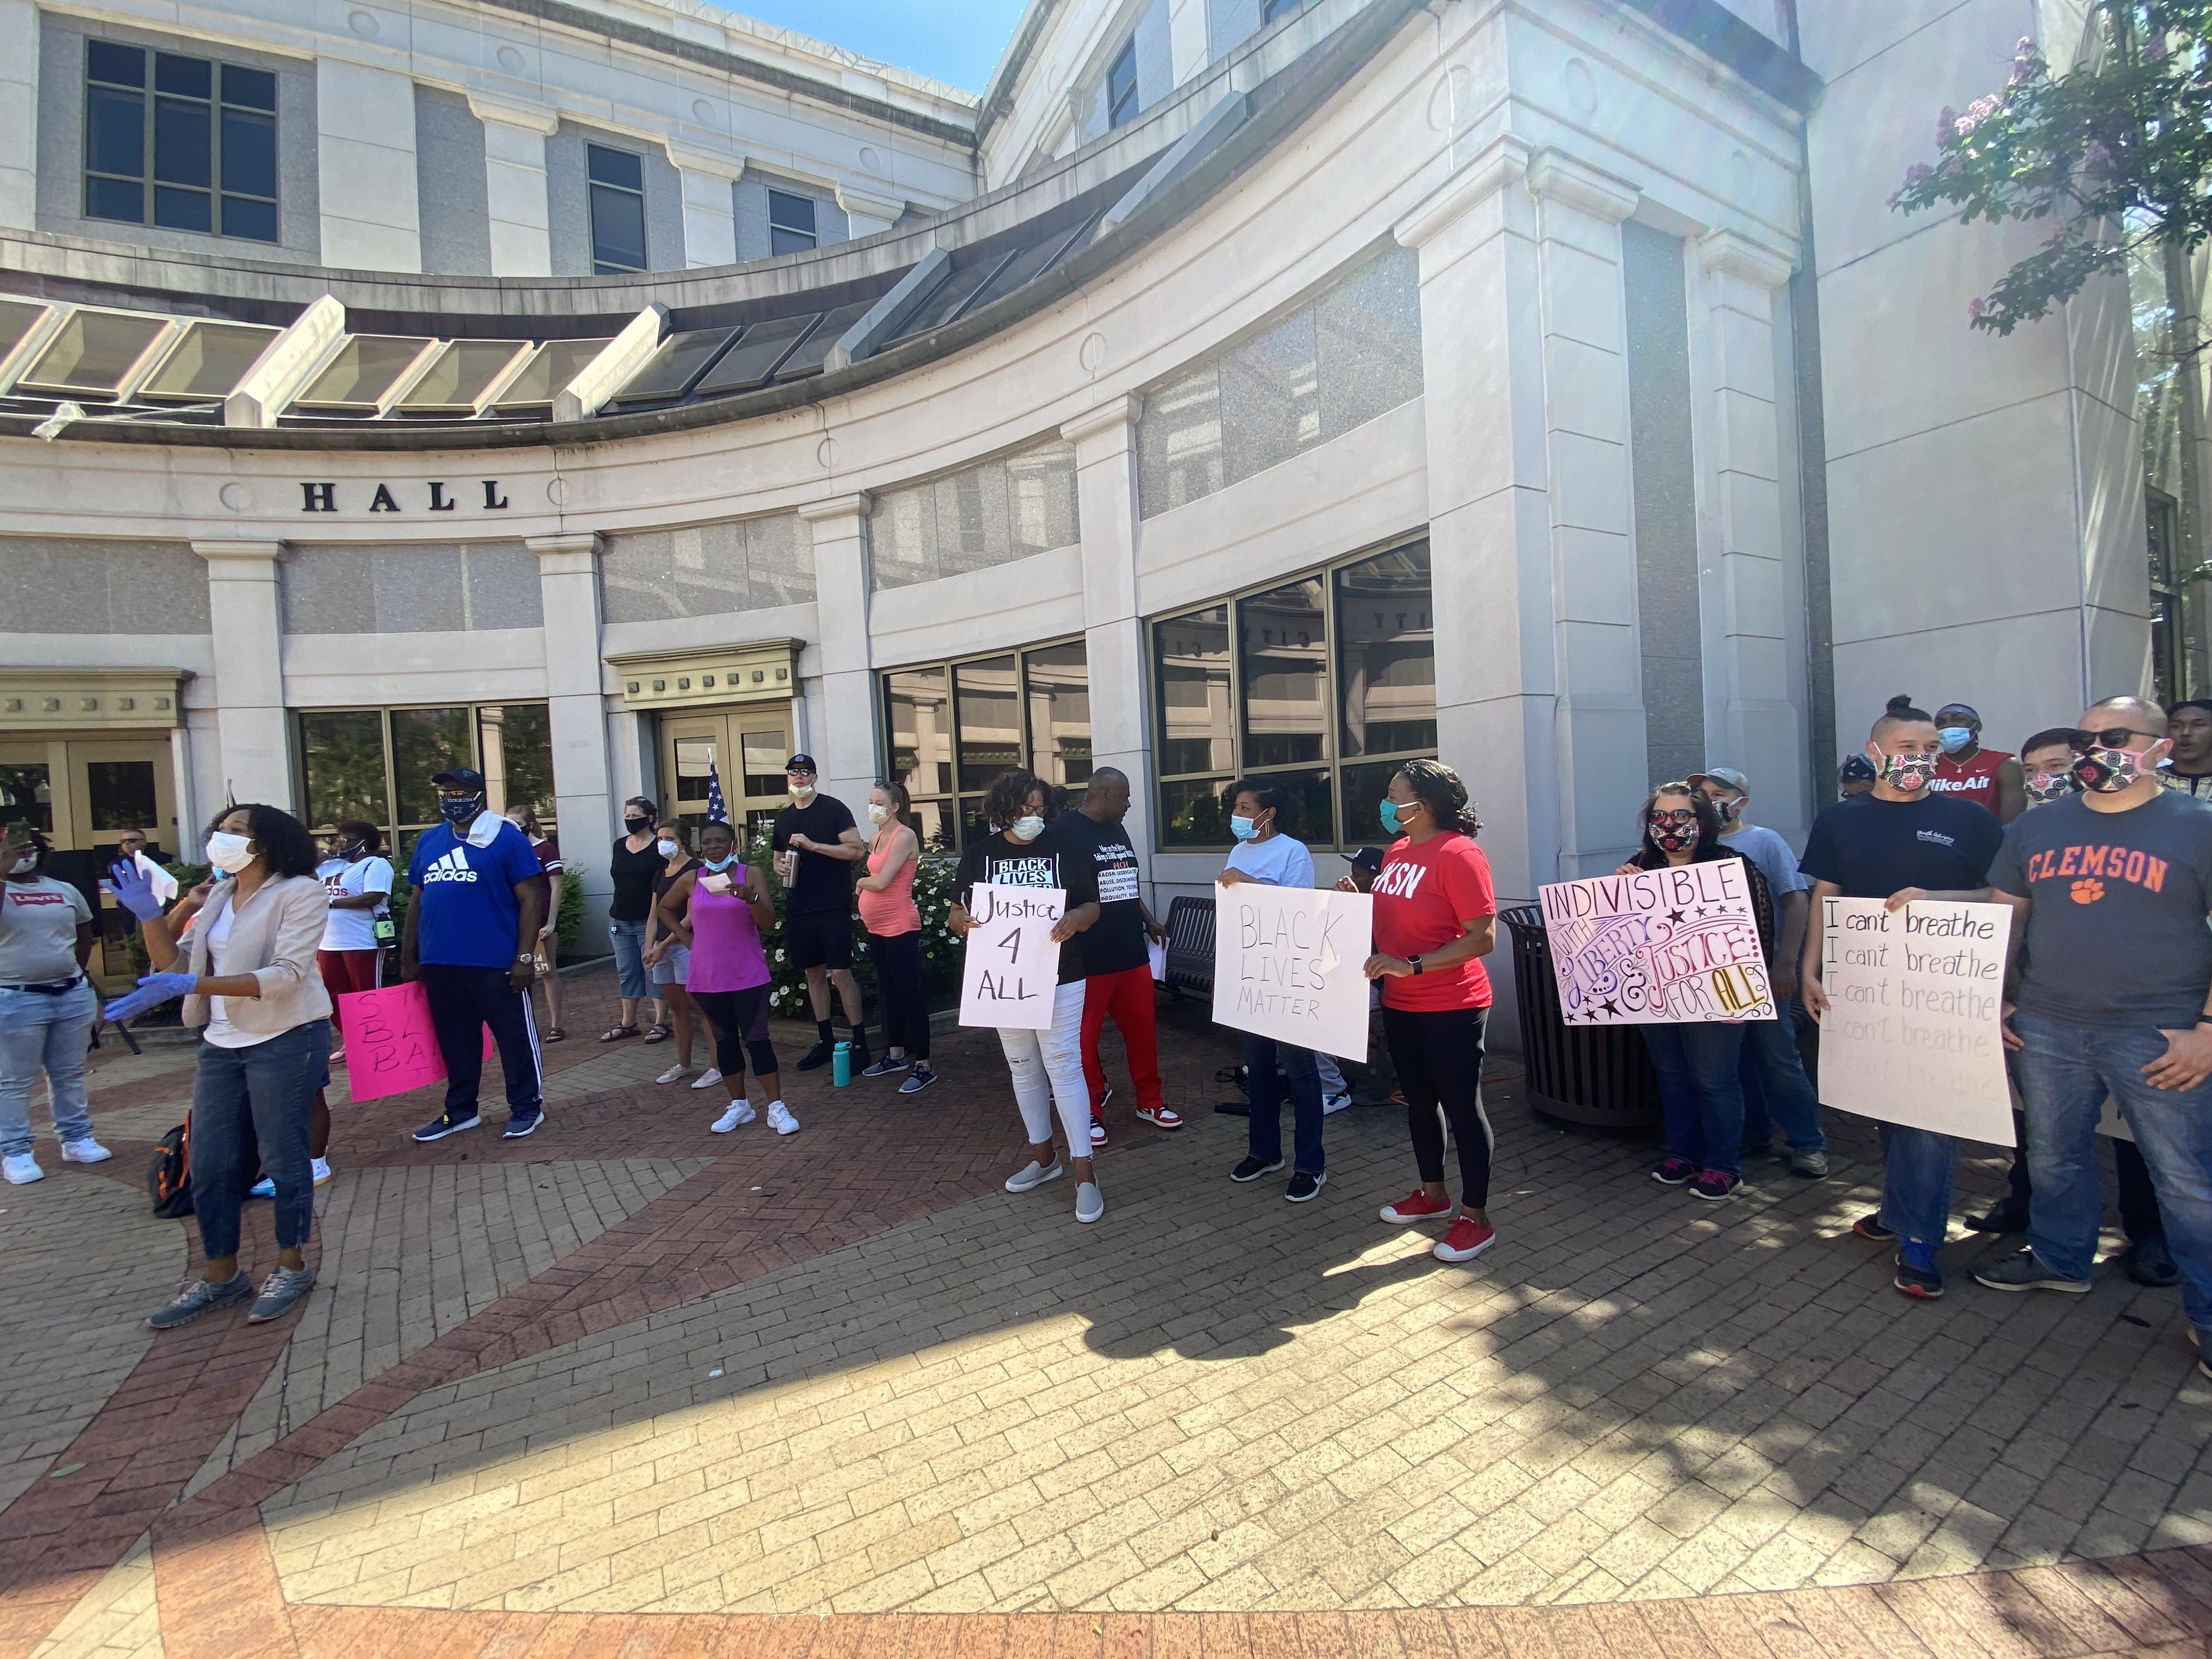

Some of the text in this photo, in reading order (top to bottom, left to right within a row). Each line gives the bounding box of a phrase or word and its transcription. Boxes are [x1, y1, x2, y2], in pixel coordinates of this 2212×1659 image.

[300, 481, 508, 512] HALL
[424, 868, 478, 884] adidas
[999, 859, 1047, 874] BLACK
[1000, 871, 1046, 884] LIVES
[1371, 862, 1427, 899] KSN
[2029, 845, 2168, 893] CLEMSON
[975, 890, 1058, 924] Justice
[1546, 862, 1741, 920] INDIVISIBLE
[1240, 905, 1344, 962] BLACK
[1552, 918, 1594, 956] WITH
[1825, 901, 1994, 939] I can't breathe
[997, 927, 1021, 964] 4
[1562, 916, 1654, 1009] LIBERTY
[1827, 936, 1997, 980] I can't breathe
[534, 963, 549, 972] SM
[978, 969, 1039, 1000] ALL
[1242, 953, 1324, 990] LIVES
[1636, 923, 1752, 1009] JUSTICE
[1238, 986, 1319, 1020] MATTER
[1666, 964, 1765, 1019] FOR ALL
[1825, 971, 1838, 997] I
[1901, 980, 1995, 1021] breathe
[1901, 1015, 1989, 1058] breathe
